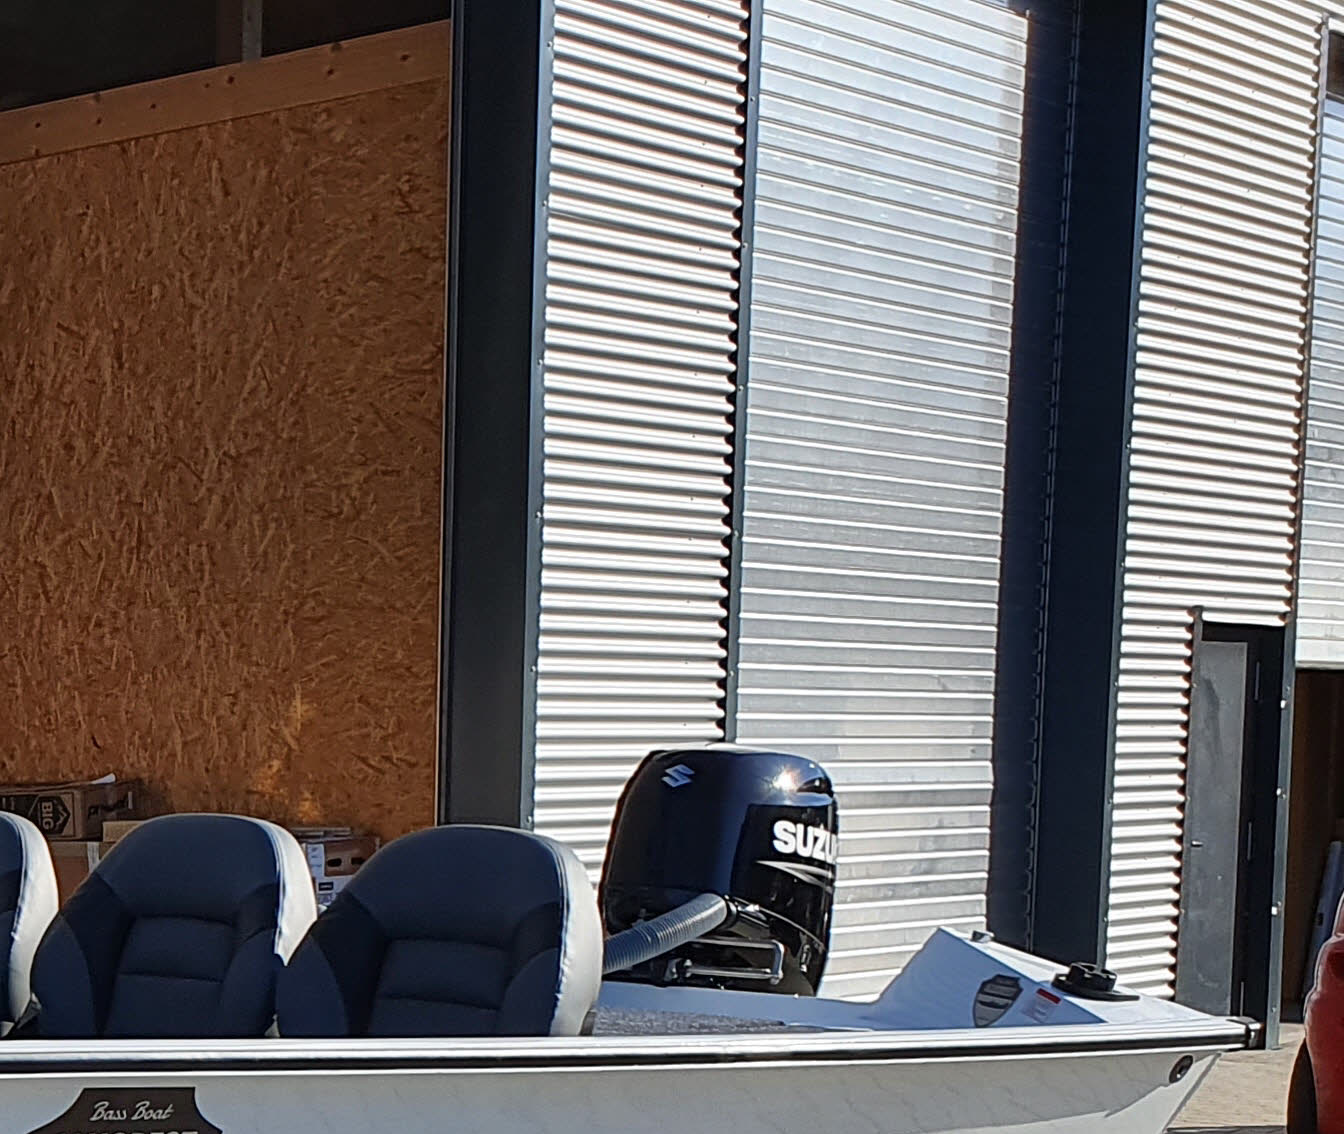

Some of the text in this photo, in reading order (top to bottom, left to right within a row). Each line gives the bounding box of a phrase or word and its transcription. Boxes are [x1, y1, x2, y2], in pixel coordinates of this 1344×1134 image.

[41, 802, 54, 830] BIG
[772, 819, 837, 864] SUZU
[89, 1100, 175, 1121] Bass Boat
